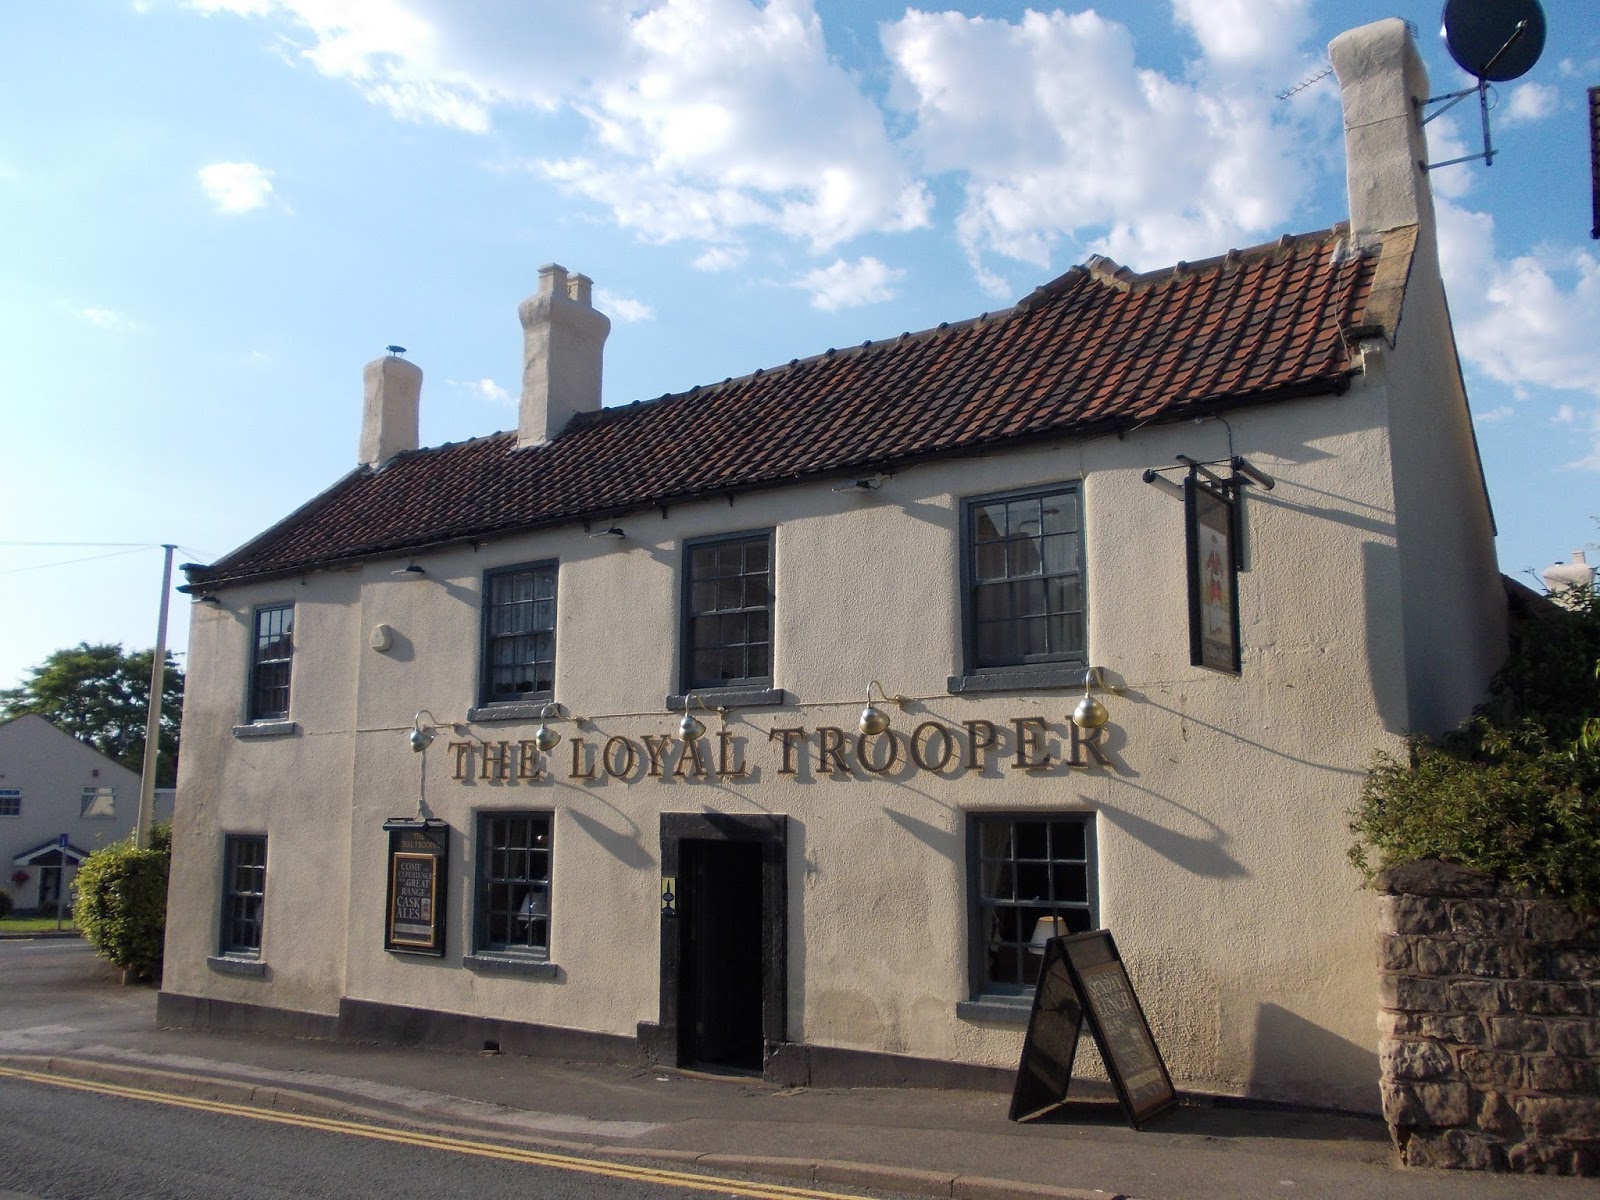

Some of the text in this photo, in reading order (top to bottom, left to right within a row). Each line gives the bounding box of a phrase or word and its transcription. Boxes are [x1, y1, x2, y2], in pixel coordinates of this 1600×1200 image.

[449, 714, 1112, 780] THE LOYAL TROOPER
[400, 862, 422, 872] COME
[397, 870, 432, 880] EXPERIENCE
[405, 879, 430, 889] GREAT
[401, 887, 426, 897] RANGE
[396, 895, 421, 909] CASK
[395, 907, 421, 920] ALES
